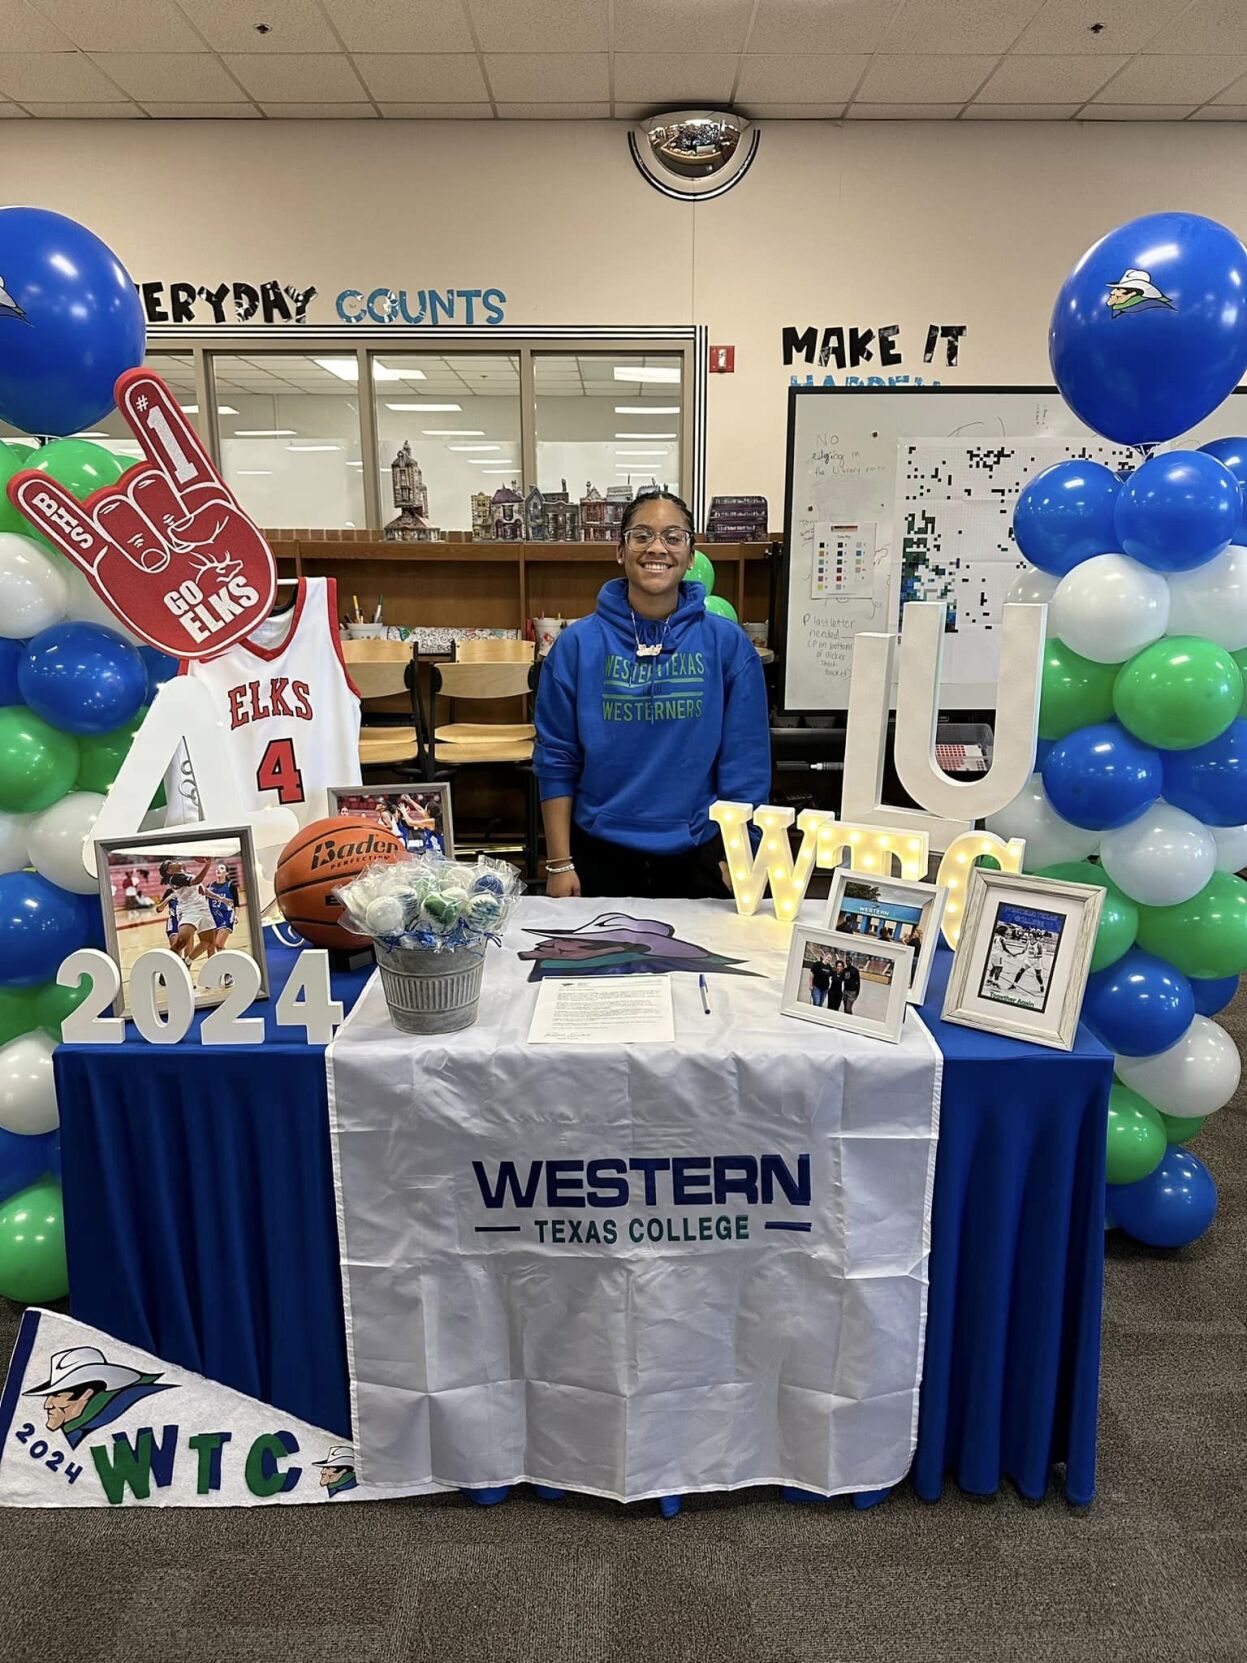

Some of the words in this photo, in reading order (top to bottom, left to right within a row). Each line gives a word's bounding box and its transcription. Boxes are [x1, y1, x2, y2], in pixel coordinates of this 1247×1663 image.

[134, 280, 318, 324] ERYDAY
[335, 287, 507, 325] COUNTS
[782, 324, 902, 370] MAKE
[923, 324, 967, 367] IT
[816, 433, 840, 448] NO
[31, 492, 94, 549] BHS
[163, 580, 204, 616] GO
[178, 575, 260, 644] ELKS
[228, 676, 315, 730] ELKS
[602, 699, 703, 721] WESTERNERS
[256, 737, 306, 806] 4
[310, 834, 399, 871] Bader
[858, 906, 890, 916] WESTERN
[55, 947, 345, 1046] 2024
[471, 1153, 812, 1208] WESTERN
[534, 1219, 618, 1245] TEXAS
[629, 1214, 750, 1244] COLLEGE
[15, 1422, 84, 1485] 2024
[90, 1424, 302, 1504] WTC
